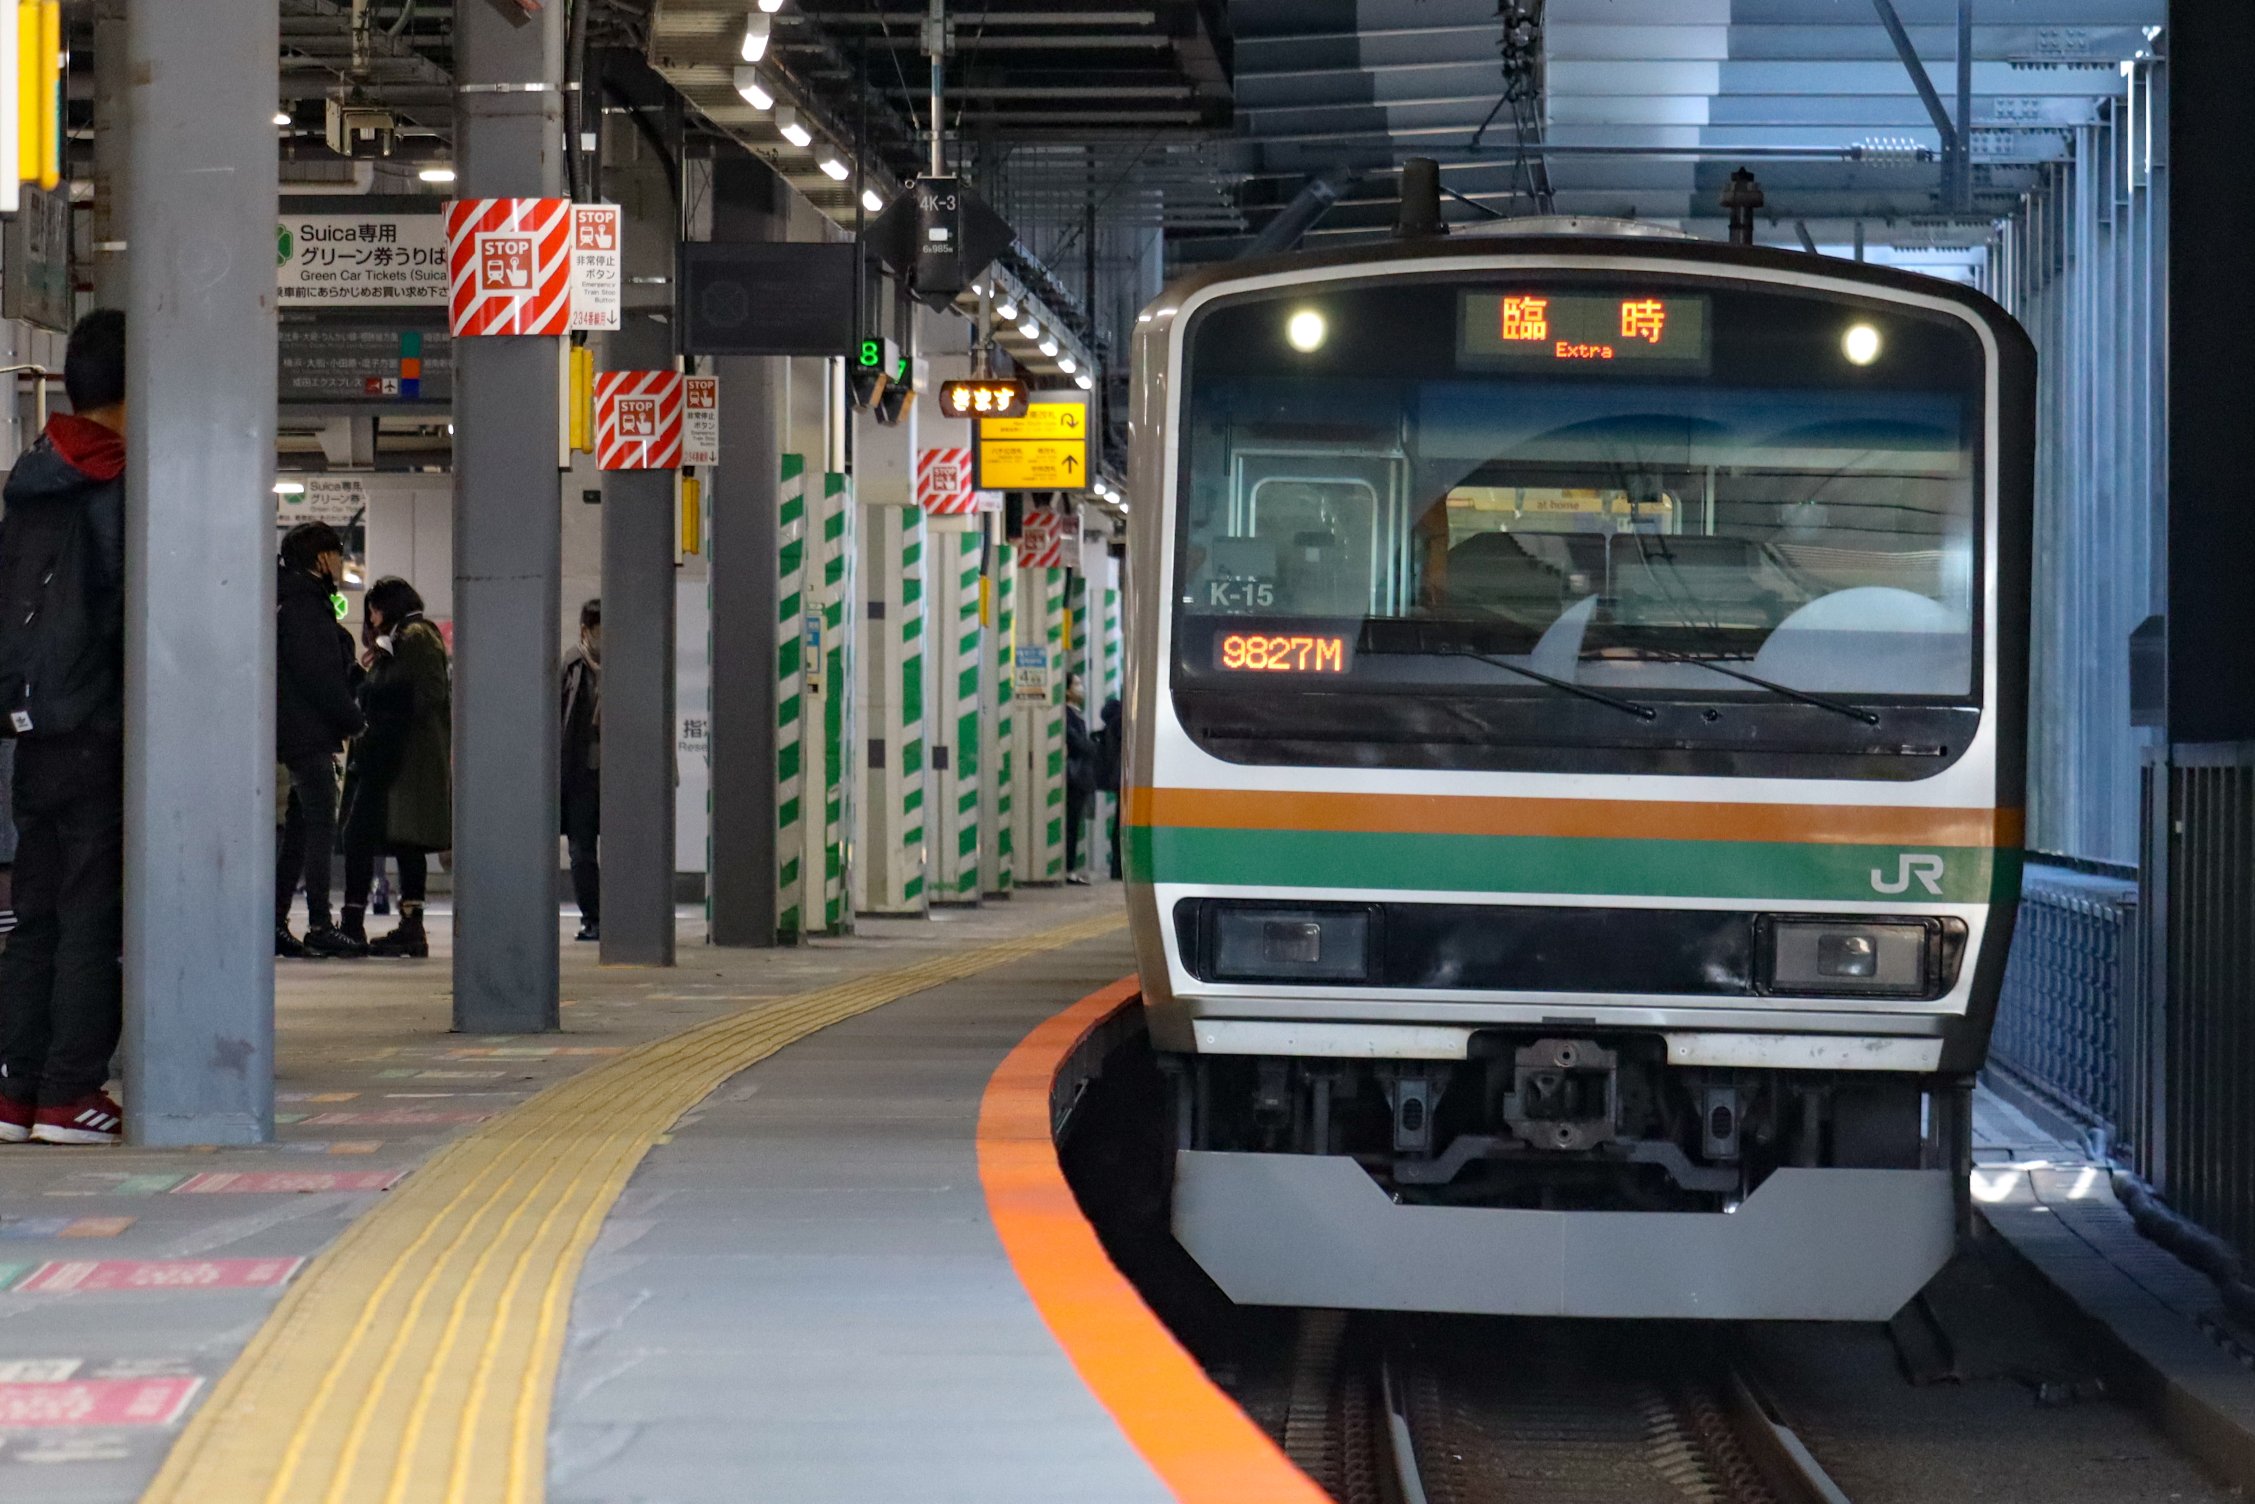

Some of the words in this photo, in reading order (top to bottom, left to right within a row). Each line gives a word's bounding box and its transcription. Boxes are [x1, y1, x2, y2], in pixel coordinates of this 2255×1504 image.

[920, 195, 956, 212] 4K-3
[578, 212, 614, 223] STOP
[301, 224, 397, 243] Suica専用
[485, 242, 529, 255] STOP
[301, 247, 447, 267] グリーン券うりば
[577, 256, 615, 266] 非常停止
[301, 270, 336, 281] Green
[341, 270, 361, 281] Car
[366, 269, 407, 281] Tickets
[411, 269, 447, 283] (Suica
[586, 269, 615, 280] ボタン
[1503, 297, 1665, 343] 臨時
[860, 341, 878, 366] 8
[1556, 342, 1614, 358] Extra
[689, 381, 714, 390] STOP
[621, 402, 653, 412] STOP
[1211, 582, 1273, 606] K-15
[1223, 635, 1342, 671] 9827M
[1871, 854, 1944, 894] JR
